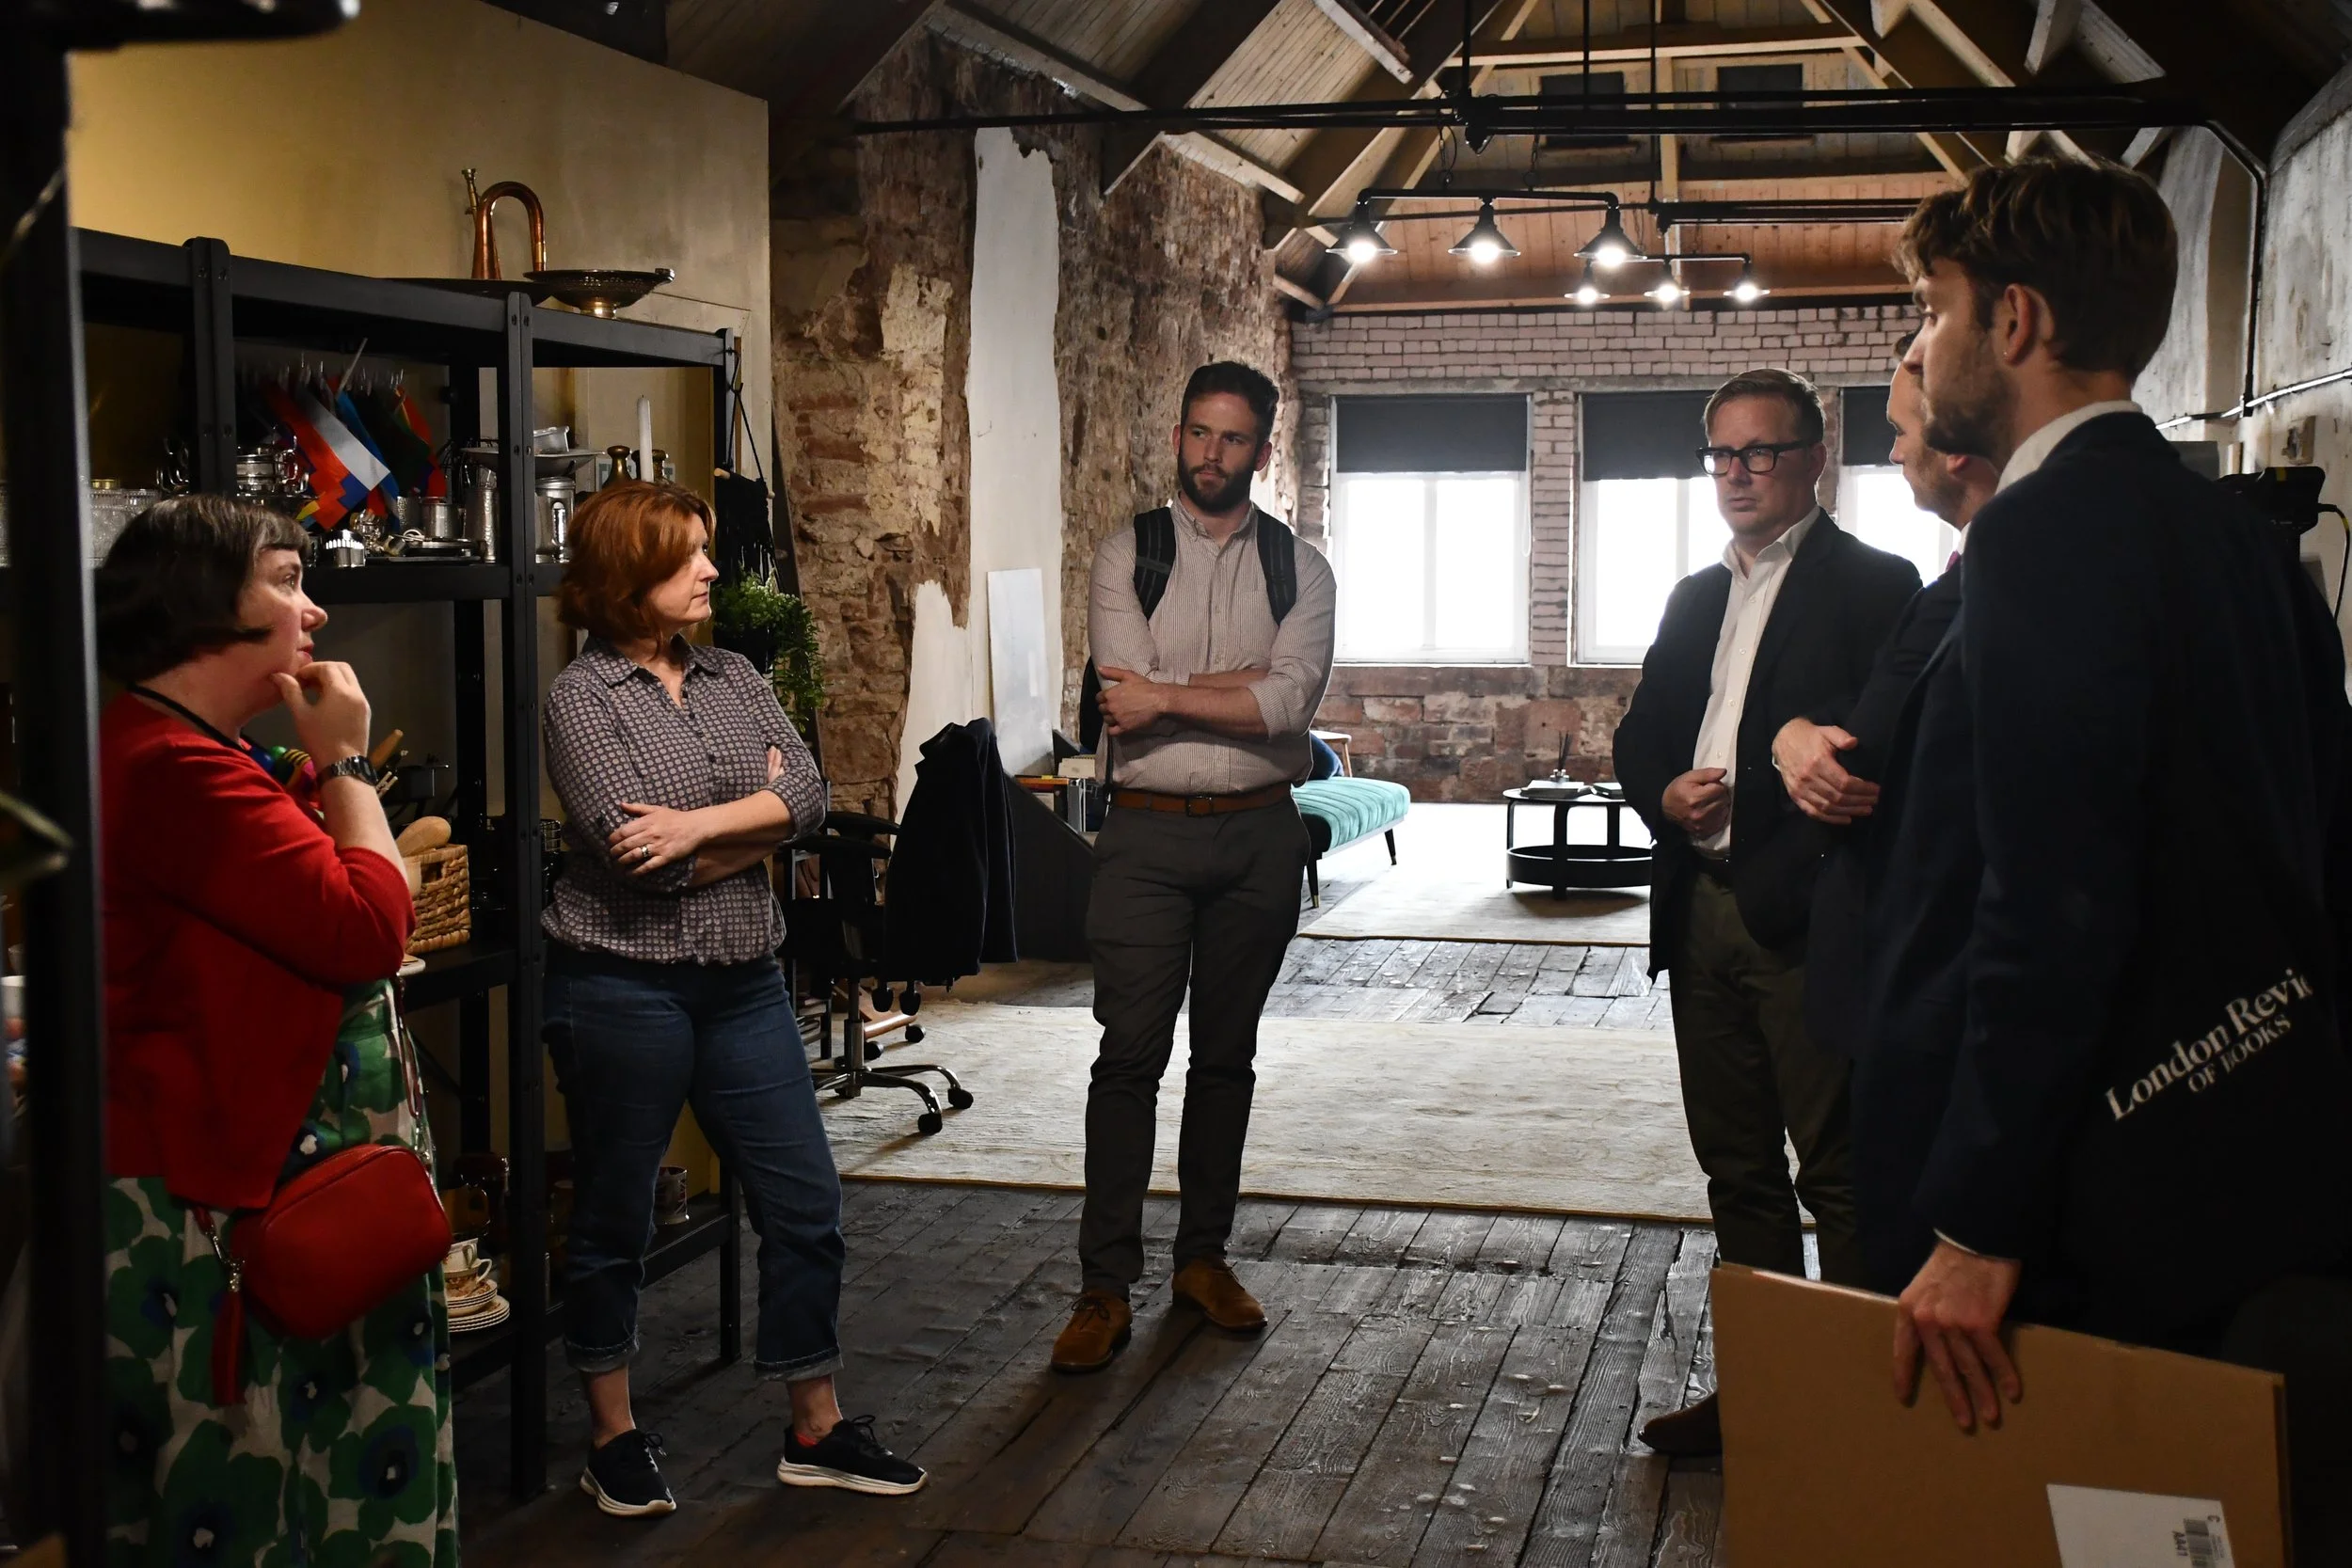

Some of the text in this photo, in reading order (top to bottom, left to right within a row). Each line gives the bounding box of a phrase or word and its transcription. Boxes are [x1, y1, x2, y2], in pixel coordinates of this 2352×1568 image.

[2105, 1024, 2232, 1122] London
[2188, 1014, 2292, 1093] OF BOOKS
